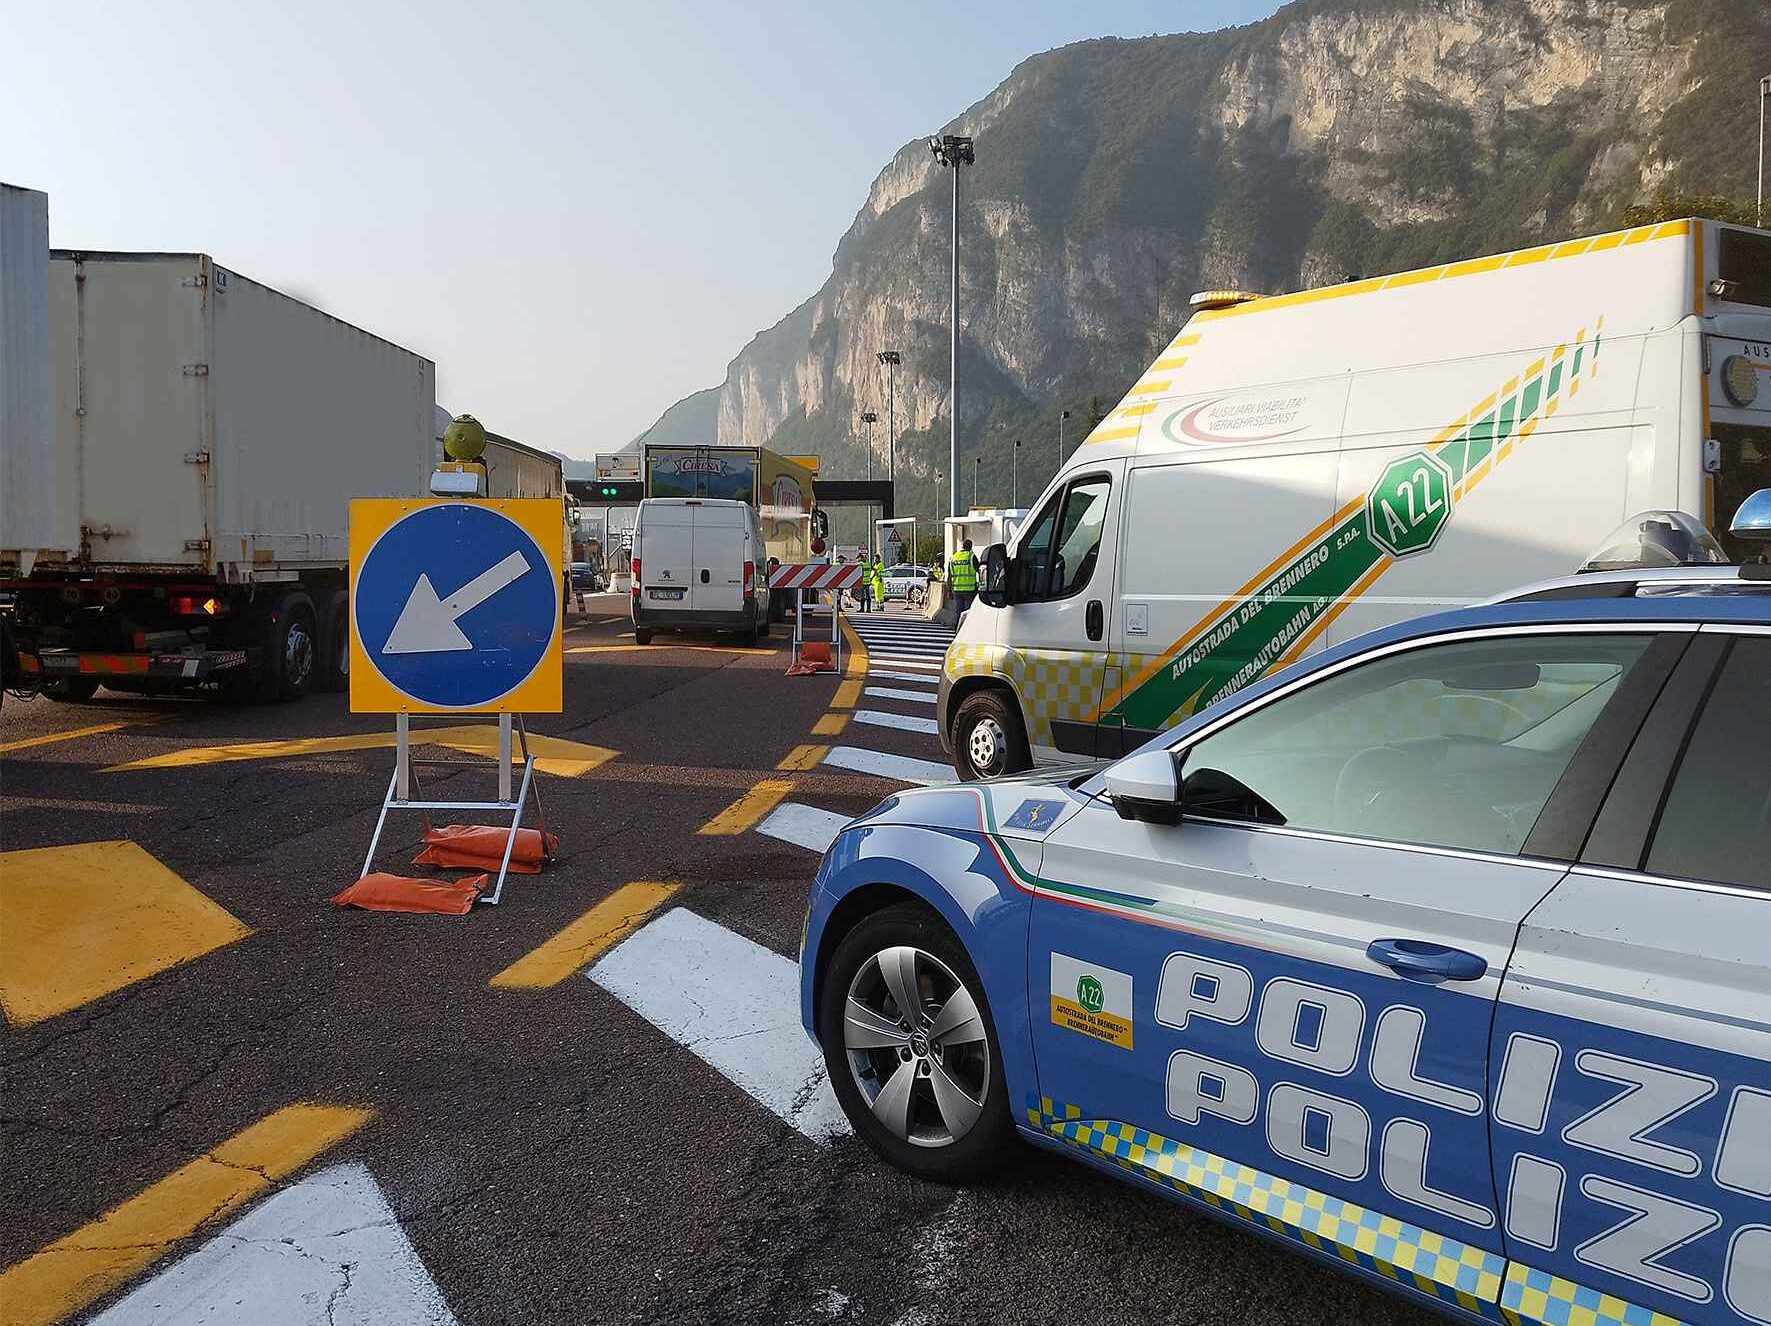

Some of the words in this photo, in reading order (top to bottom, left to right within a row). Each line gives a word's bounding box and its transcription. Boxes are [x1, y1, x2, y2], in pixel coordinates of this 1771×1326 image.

[1171, 616, 1240, 680] AUTOSTRADA
[1240, 598, 1263, 625] DEL
[1264, 545, 1329, 606] BRENNERO
[1056, 1004, 1087, 1021] AUTOSTRADA
[1088, 1015, 1097, 1024] DEL
[1097, 1017, 1124, 1034] BRENNERO
